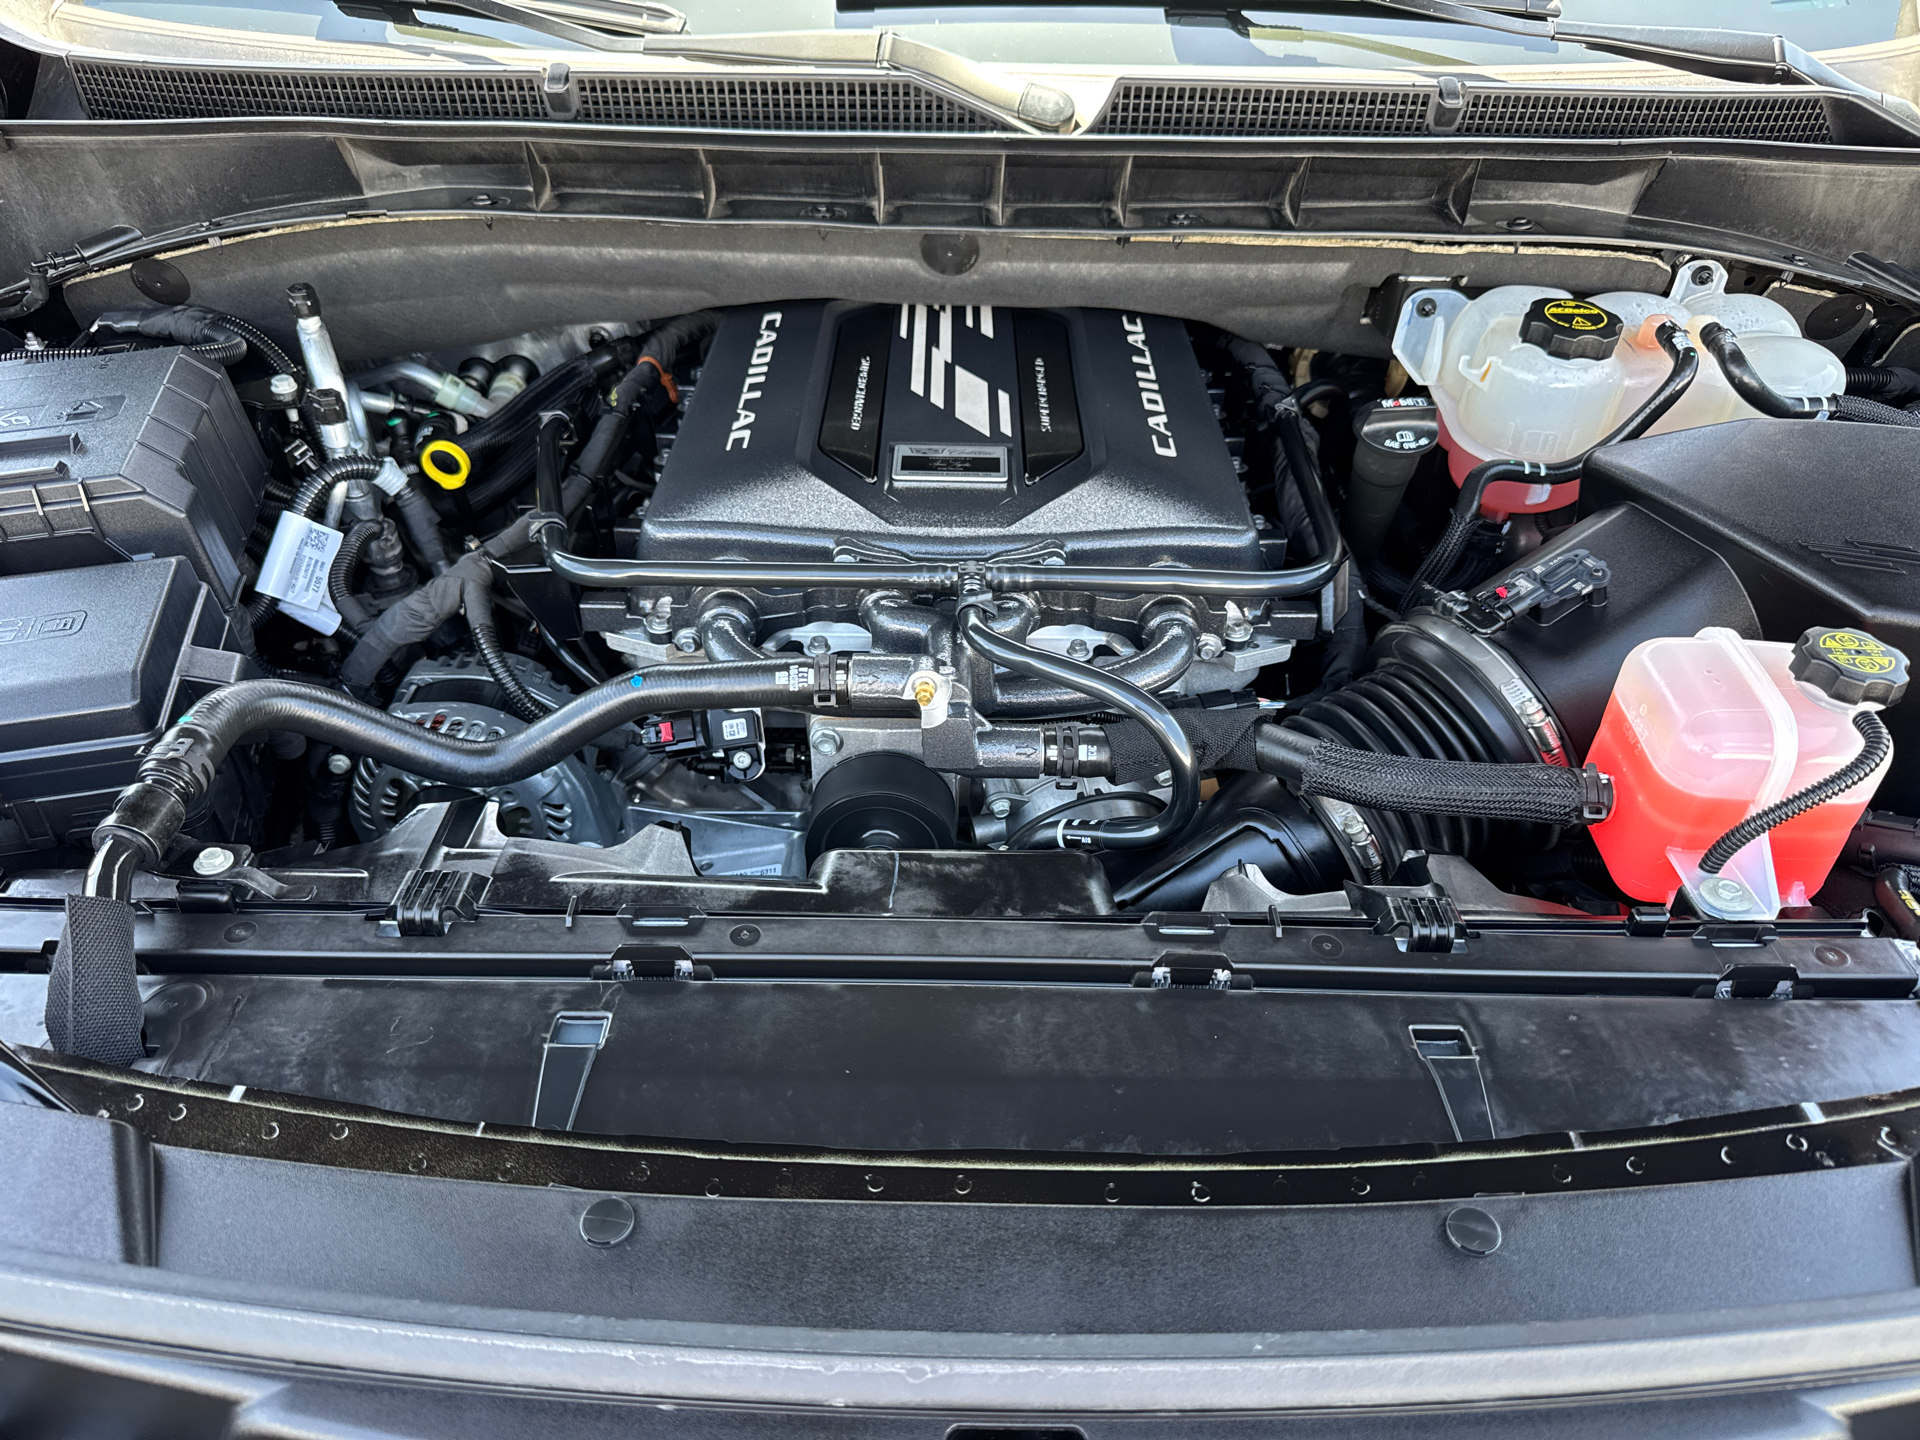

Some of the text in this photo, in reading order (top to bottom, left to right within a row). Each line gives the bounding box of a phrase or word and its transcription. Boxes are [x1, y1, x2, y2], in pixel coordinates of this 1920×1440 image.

[725, 311, 783, 451] CADILLAC
[851, 355, 870, 430] SUPERCHARGED
[1034, 357, 1052, 432] SUPERCHARGED
[1121, 314, 1177, 458] CADILLAC
[1381, 398, 1414, 408] Mobil
[1384, 436, 1430, 449] SAE 0W-40
[312, 576, 323, 593] 5577
